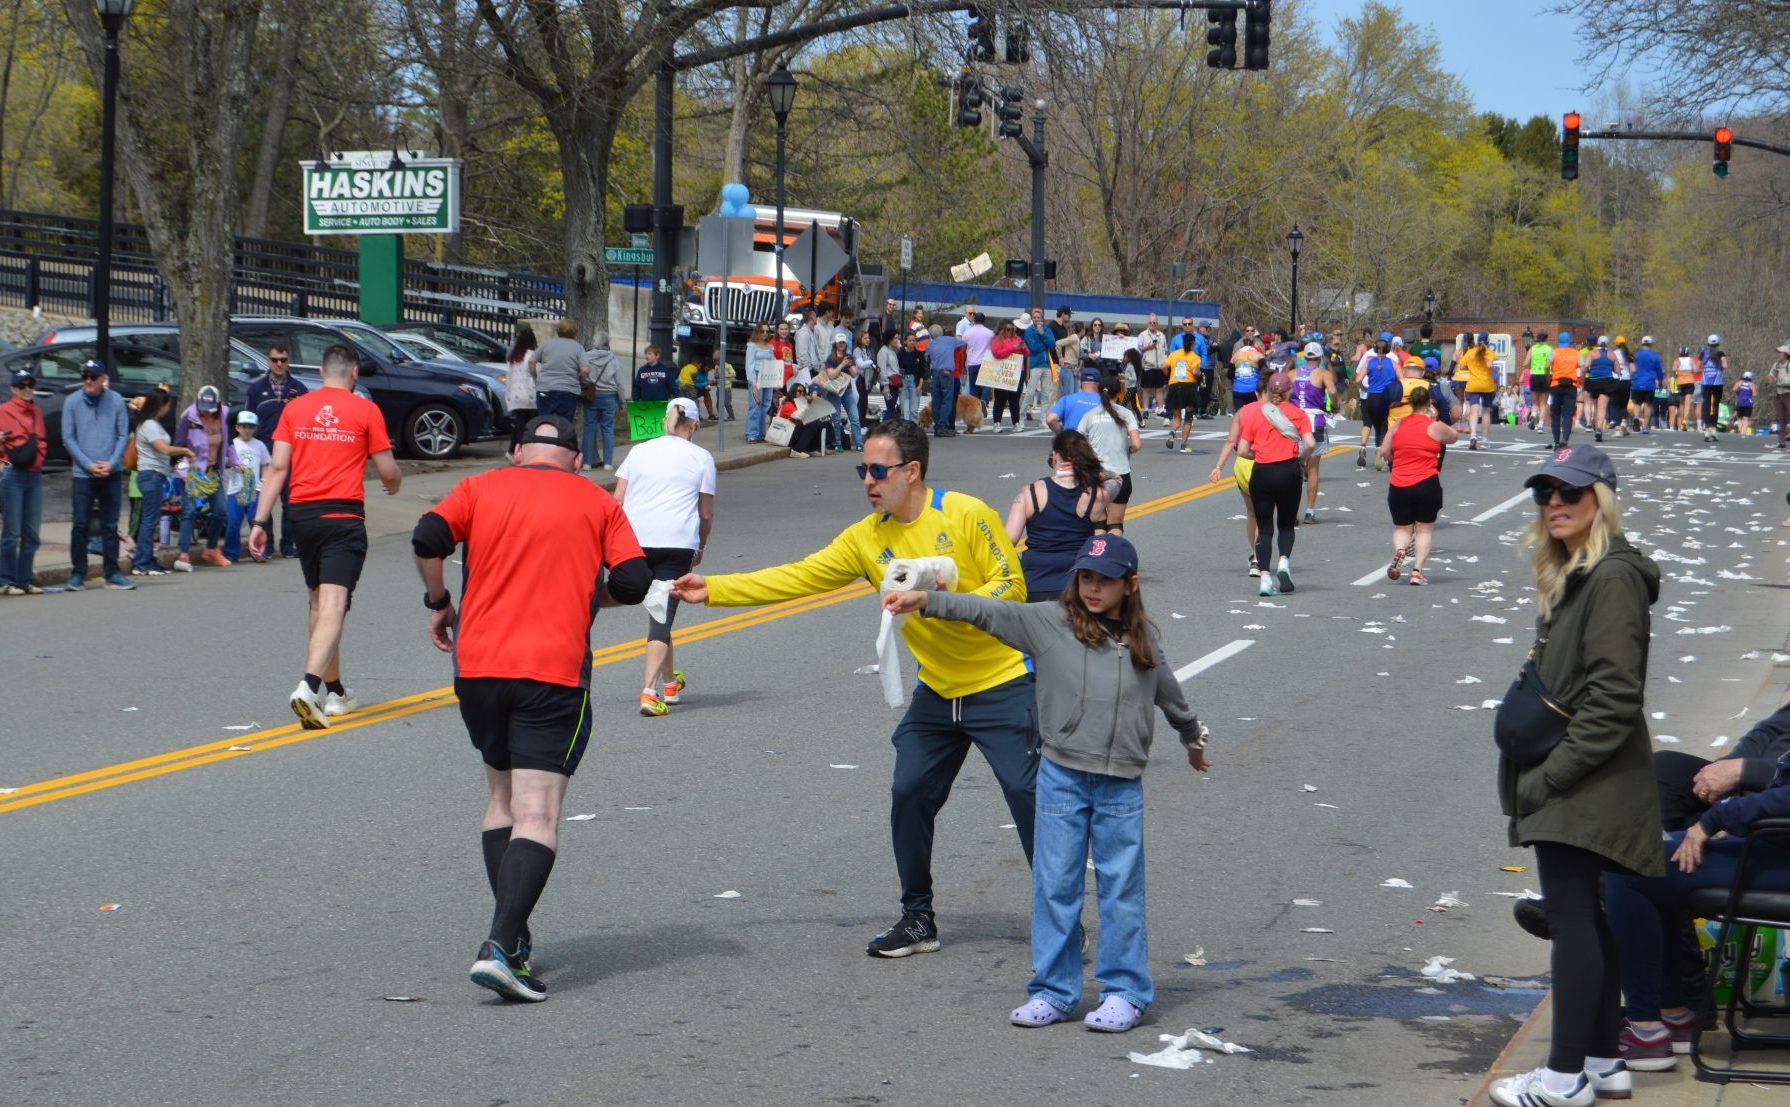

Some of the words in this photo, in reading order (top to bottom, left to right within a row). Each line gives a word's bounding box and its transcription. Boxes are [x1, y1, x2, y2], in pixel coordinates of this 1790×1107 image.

[310, 170, 445, 198] HASKINS
[330, 201, 425, 213] AUTOMOTIVE
[318, 217, 352, 227] SERVICE
[359, 216, 381, 226] AUTO
[382, 216, 404, 226] BODY
[411, 215, 438, 226] SALES
[294, 431, 356, 443] FOUNDATION
[977, 519, 993, 542] 2013
[989, 542, 1010, 578] BOSTON
[1088, 539, 1106, 556] B
